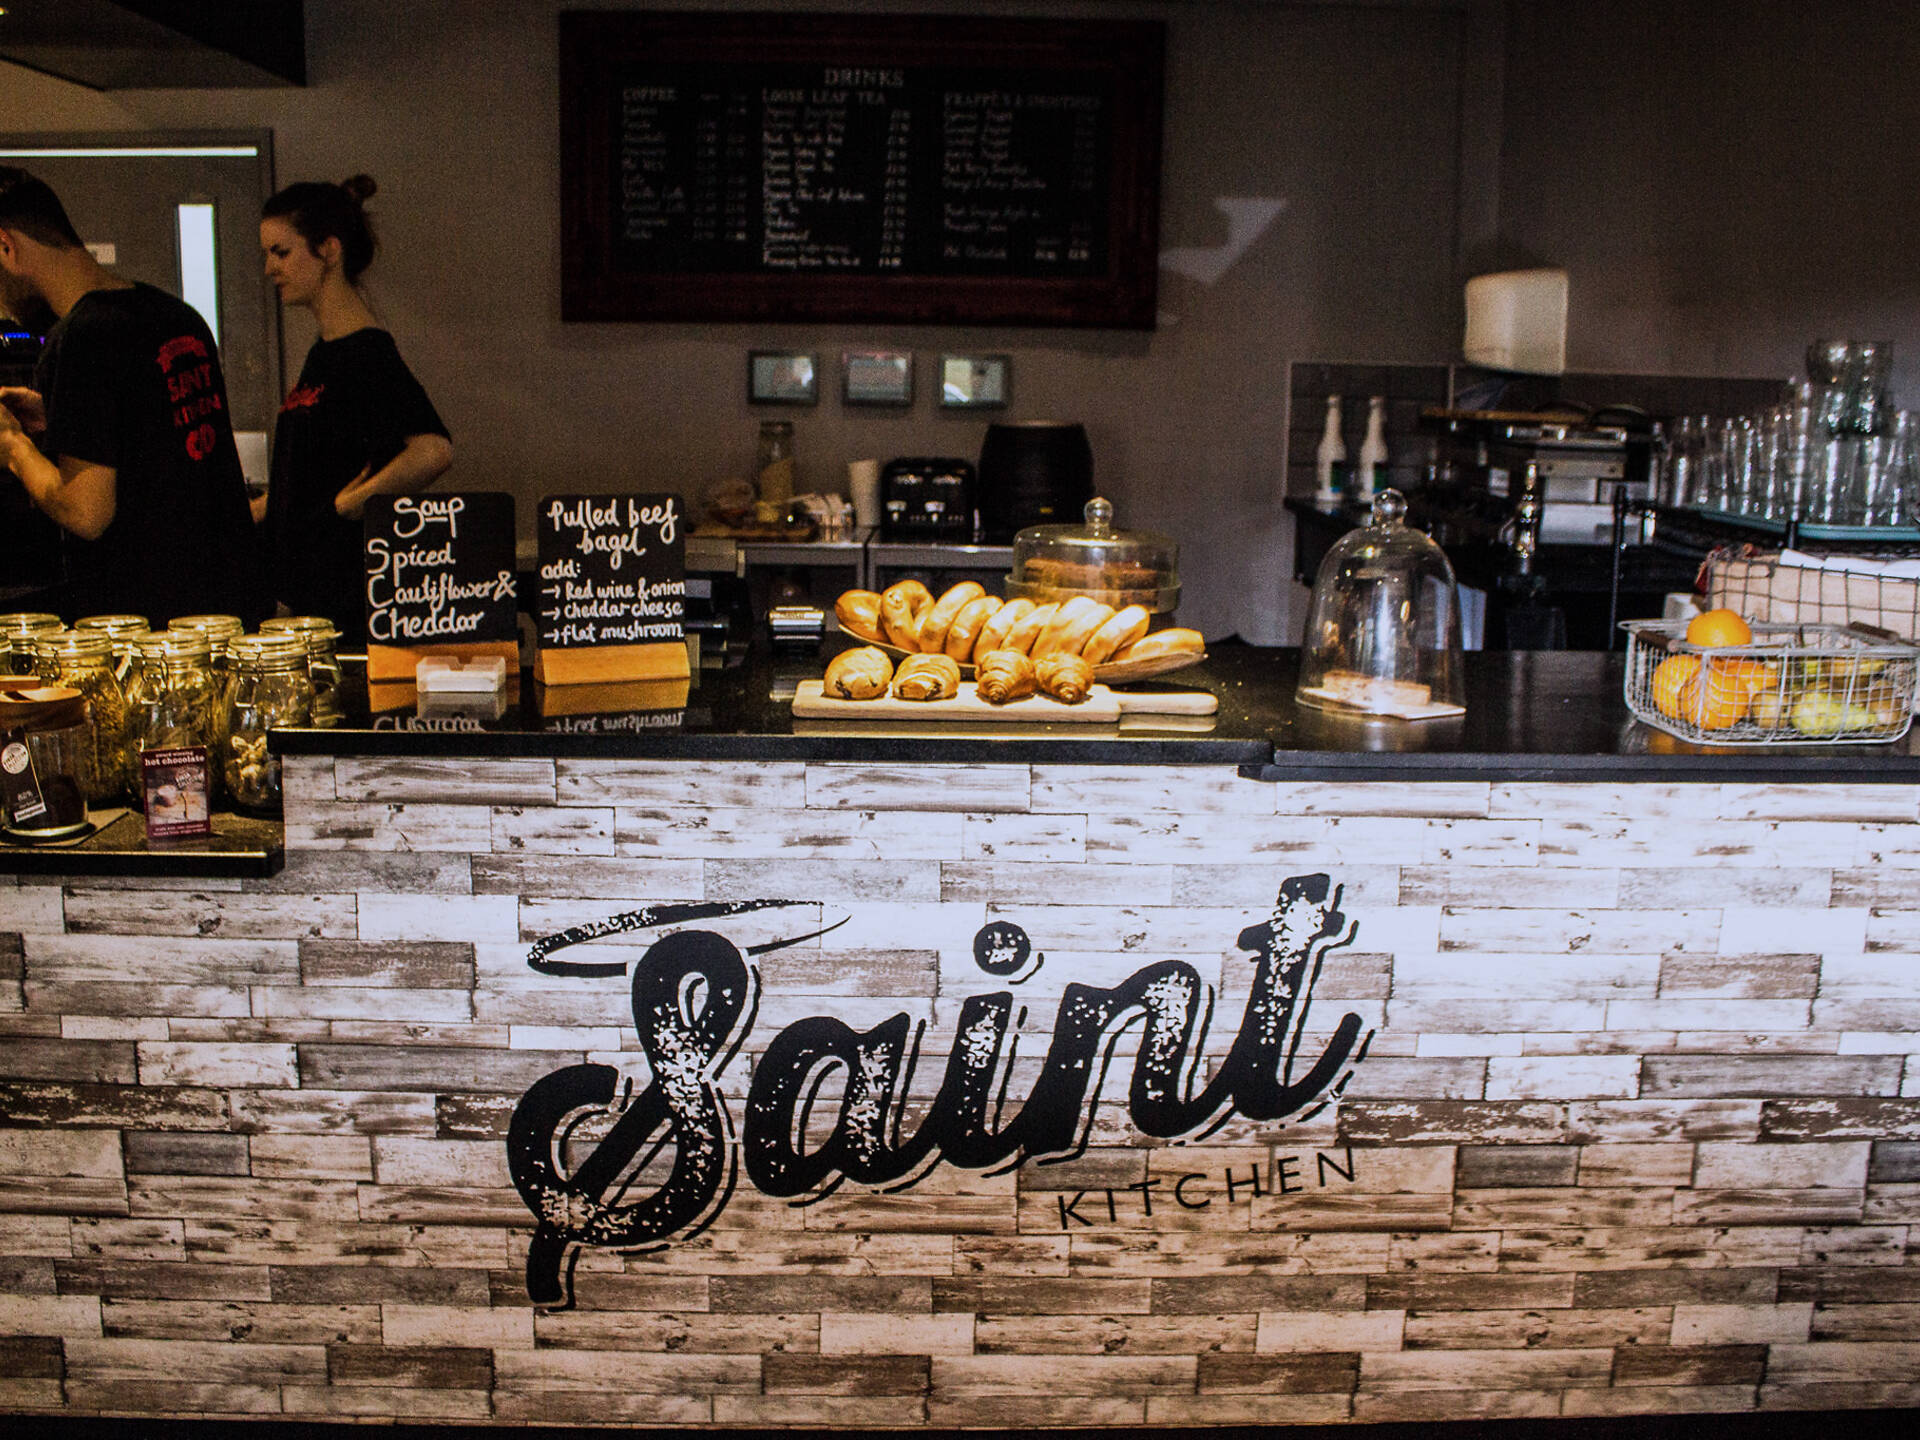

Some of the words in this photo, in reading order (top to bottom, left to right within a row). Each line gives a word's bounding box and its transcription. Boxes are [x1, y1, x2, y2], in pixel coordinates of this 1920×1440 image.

[824, 68, 904, 88] DRINKS
[856, 90, 886, 105] TEA
[393, 497, 465, 539] Soup
[547, 498, 620, 531] Pulled
[629, 497, 678, 544] beef
[367, 538, 456, 587] Spiced
[577, 528, 646, 570] bagel
[540, 558, 581, 580] add:
[565, 578, 594, 600] Red
[596, 579, 635, 598] wine
[651, 579, 685, 597] onion
[369, 607, 486, 640] Cheddar
[561, 622, 596, 645] flat
[600, 620, 684, 641] mushroom
[145, 758, 160, 766] hot
[162, 755, 205, 765] chocolate
[507, 873, 1376, 1310] Saint
[1058, 1147, 1360, 1229] KITCHEN
